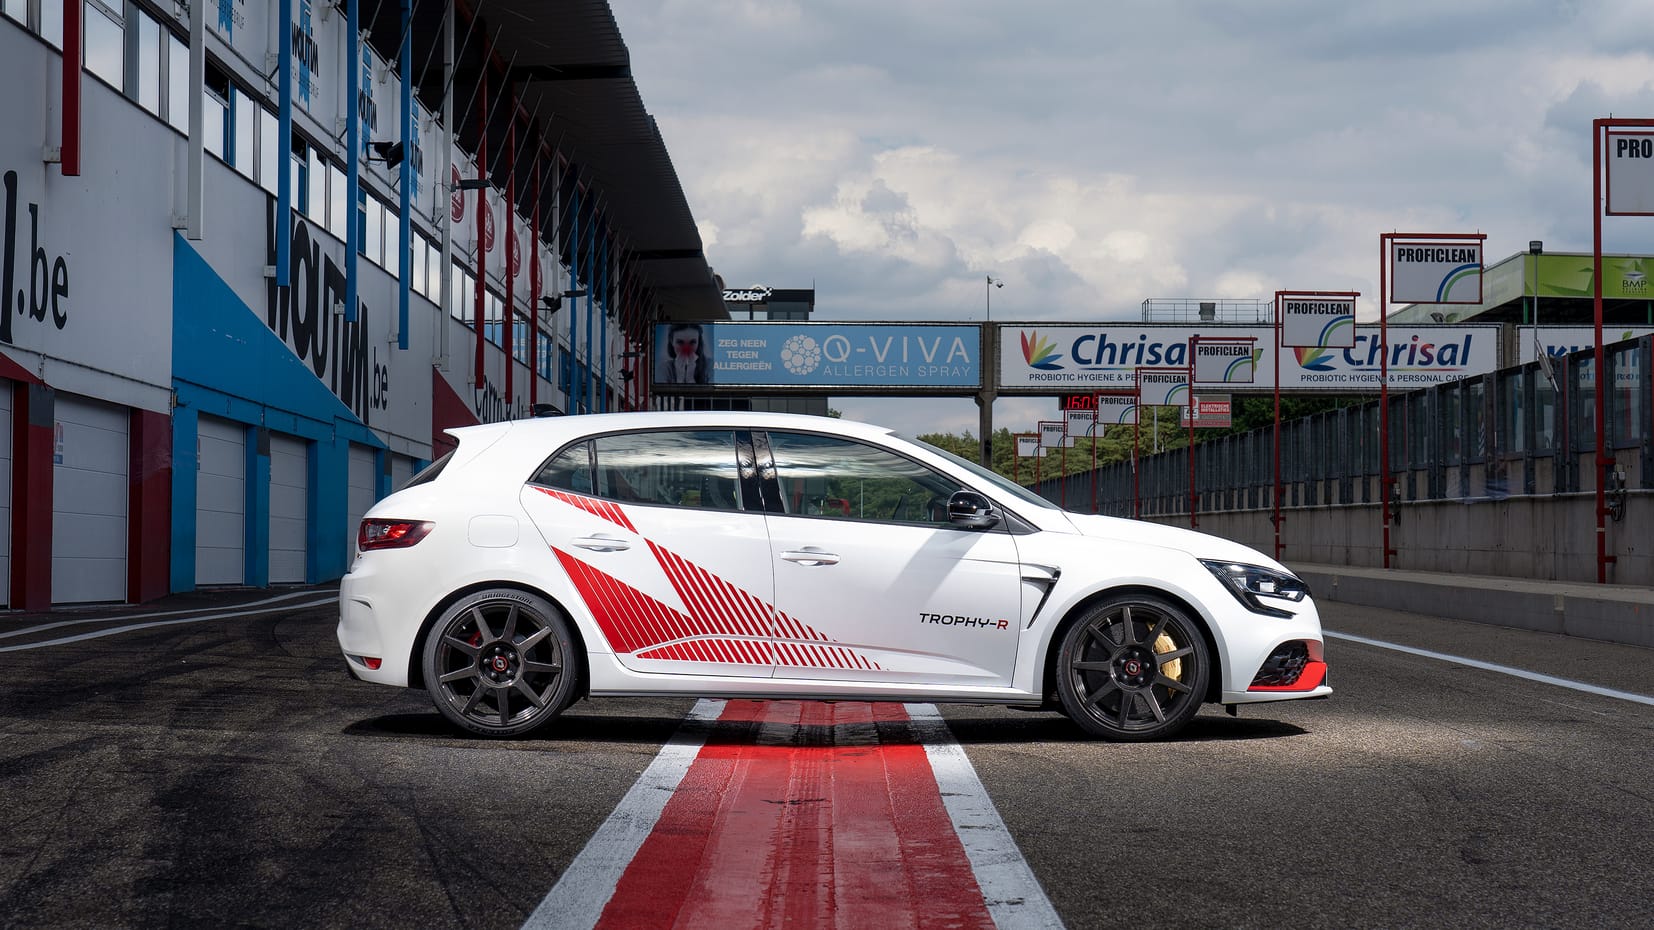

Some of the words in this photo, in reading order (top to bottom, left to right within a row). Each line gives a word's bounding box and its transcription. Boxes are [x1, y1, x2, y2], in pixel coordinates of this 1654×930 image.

[1398, 248, 1476, 263] PROFICLEAN
[1622, 280, 1647, 288] BMP
[1287, 302, 1350, 315] PROFICLEAN
[718, 339, 738, 348] ZEG
[740, 339, 767, 348] NEEN
[823, 334, 970, 363] Q-VIVA
[727, 350, 759, 359] TEGEN
[1198, 346, 1249, 356] PROFICLEAN
[823, 365, 909, 377] ALLERGEN
[918, 366, 970, 377] SPRAY
[1029, 373, 1075, 382] PROBIOTIC
[1077, 373, 1115, 382] HYGIENE
[1117, 373, 1123, 382] &
[1143, 374, 1187, 384] PROFICLEAN
[1301, 374, 1347, 382] PROBIOTIC
[1349, 374, 1383, 382] HYGIEN
[1389, 374, 1395, 382] &
[1397, 374, 1443, 382] PERSONAL
[919, 612, 1009, 630] TROPHY-R
